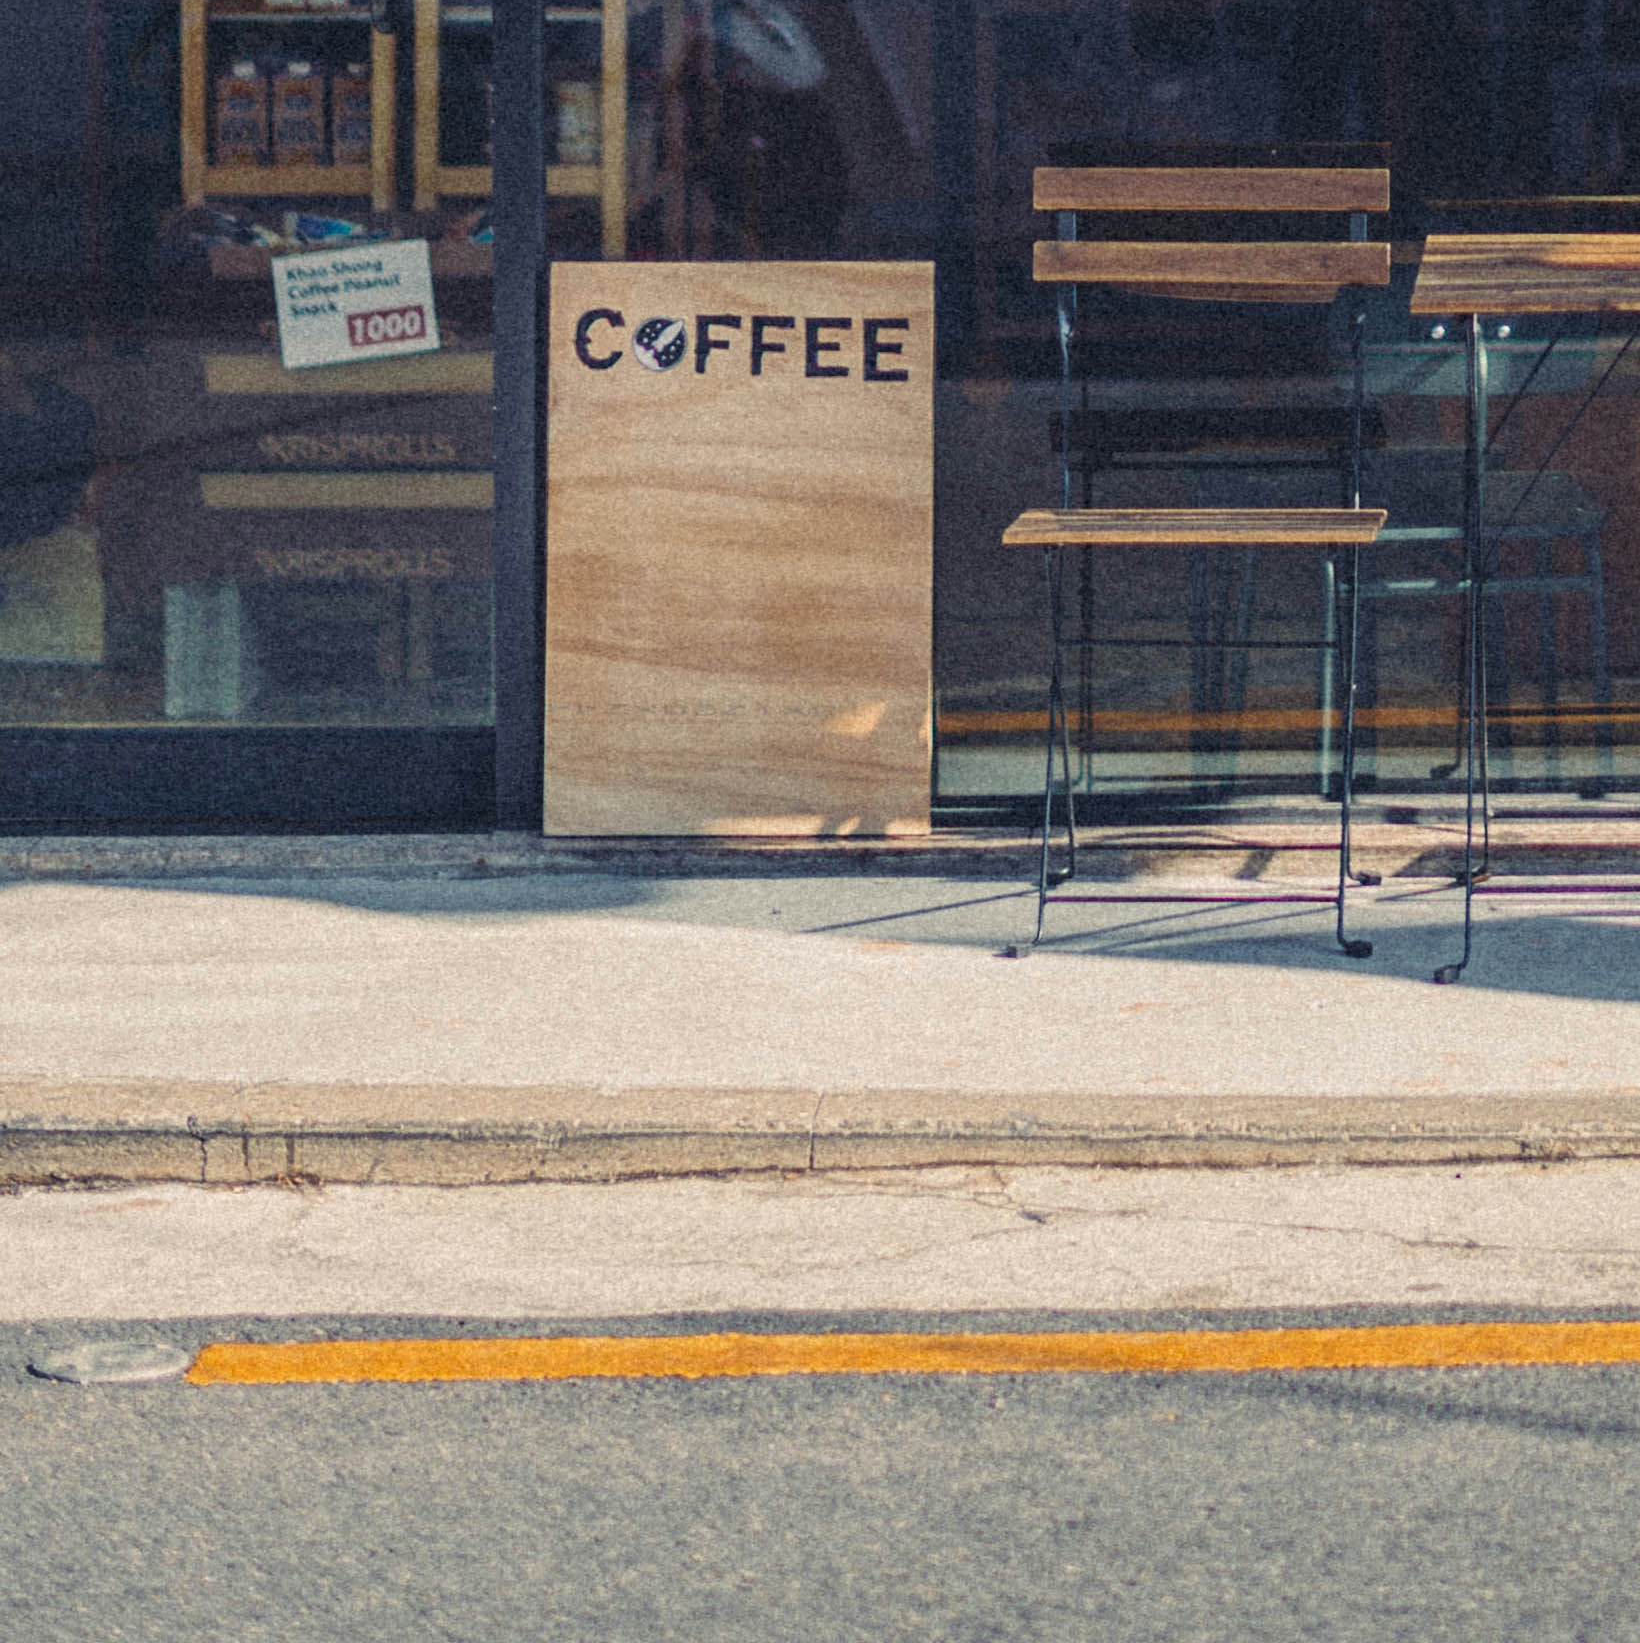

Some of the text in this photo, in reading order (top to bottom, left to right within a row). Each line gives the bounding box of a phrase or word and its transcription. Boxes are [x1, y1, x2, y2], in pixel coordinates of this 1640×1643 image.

[288, 273, 401, 299] Coffee Peanut
[289, 300, 338, 318] Snack
[352, 310, 422, 344] 1000
